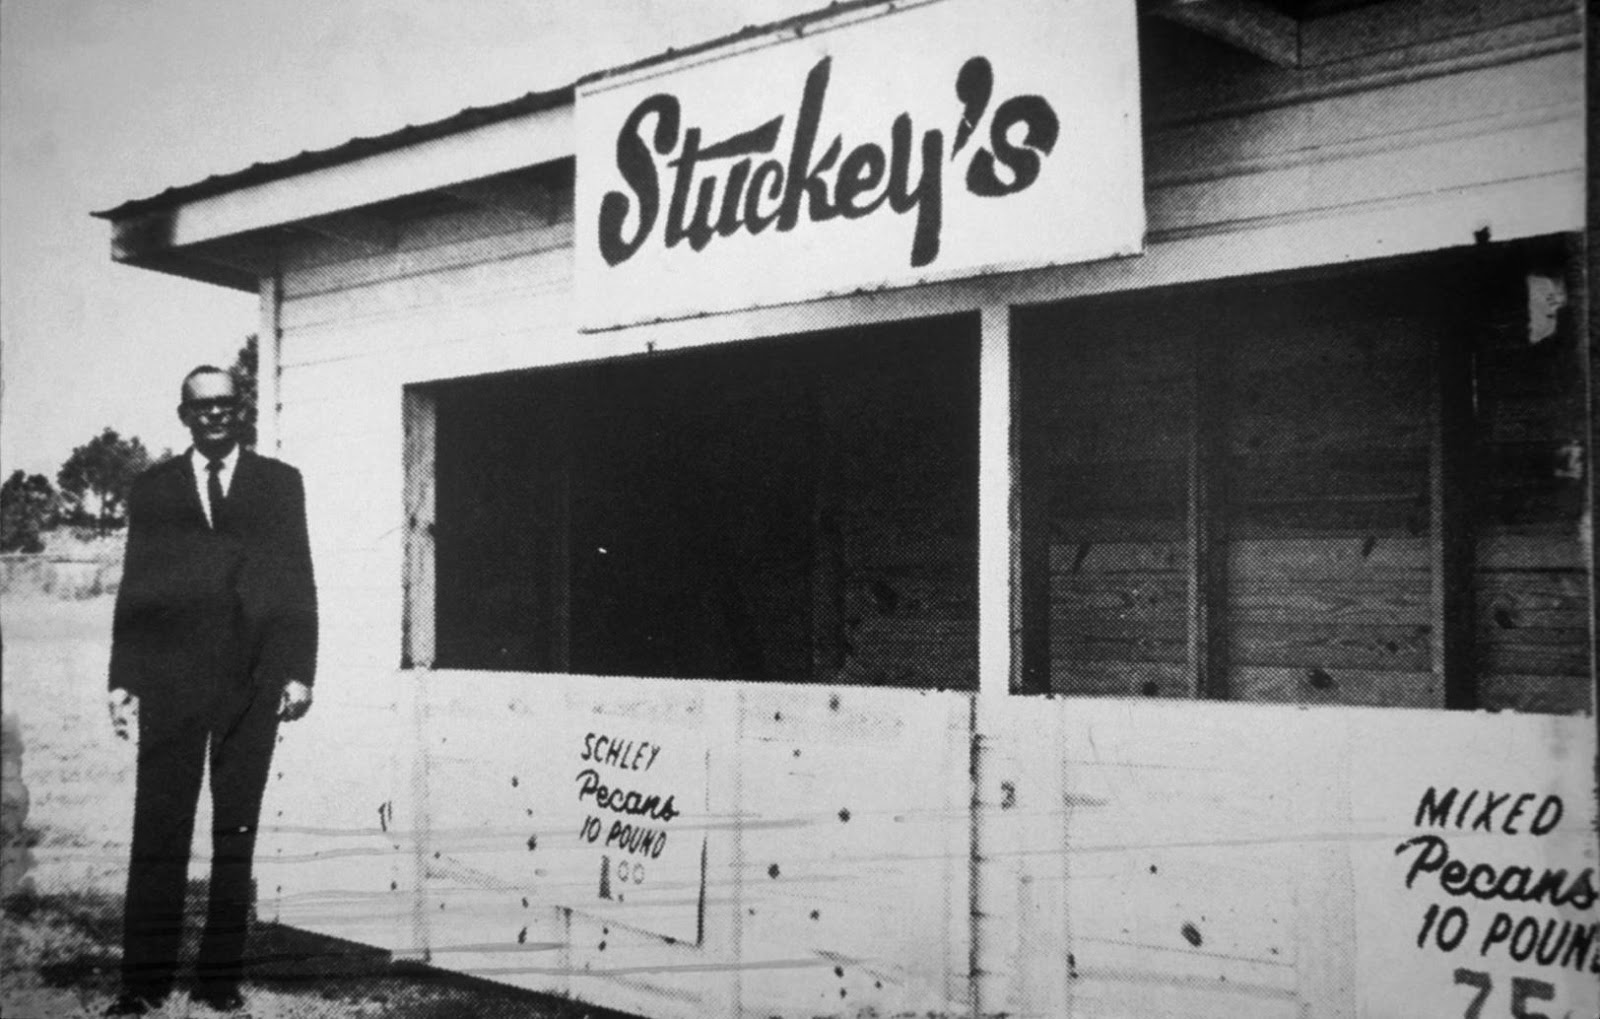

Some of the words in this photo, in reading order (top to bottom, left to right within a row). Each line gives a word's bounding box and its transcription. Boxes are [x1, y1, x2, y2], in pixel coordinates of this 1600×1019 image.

[599, 56, 1060, 267] Stuckey's
[580, 732, 661, 771] SCHLEY
[575, 769, 680, 821] Pecans
[1414, 786, 1564, 836] MIXED
[579, 815, 602, 843] 10
[605, 820, 667, 859] POUND
[1394, 835, 1599, 911] Pecans
[1417, 904, 1469, 952] 10
[1480, 913, 1600, 973] POUN
